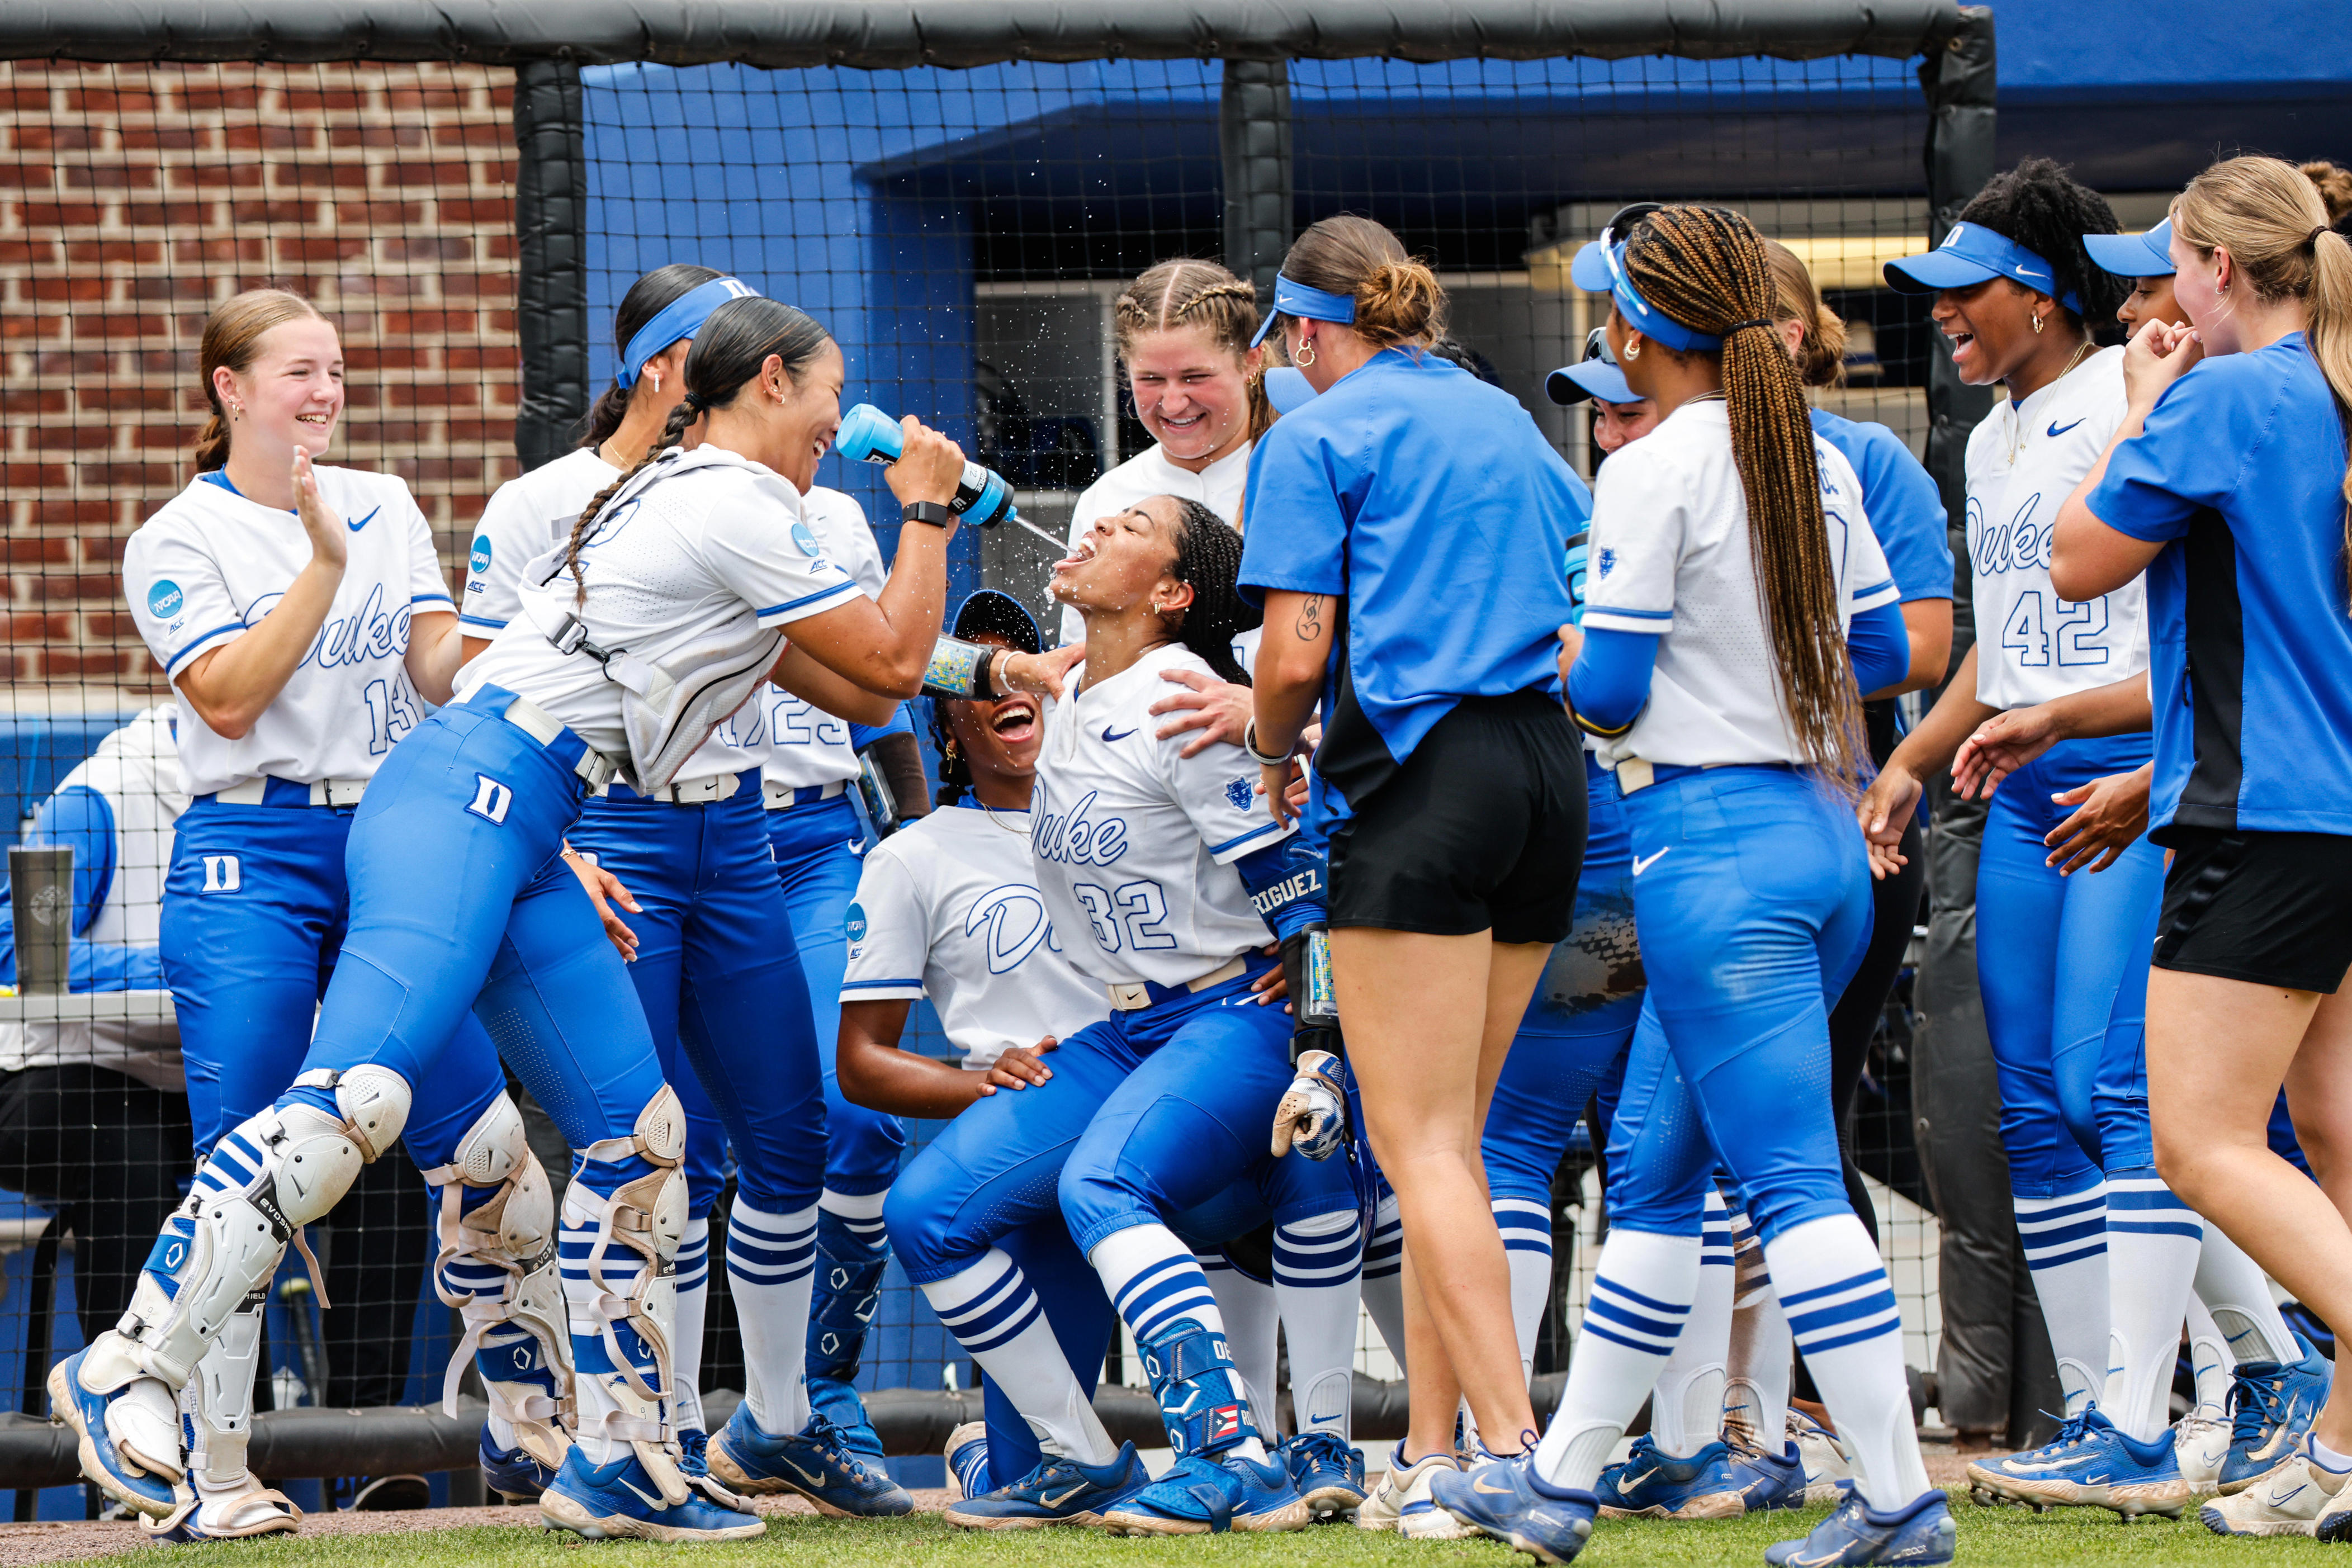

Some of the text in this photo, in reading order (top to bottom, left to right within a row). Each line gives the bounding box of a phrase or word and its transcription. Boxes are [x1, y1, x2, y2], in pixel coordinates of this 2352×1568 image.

[471, 551, 490, 564] NCAA
[810, 560, 827, 572] ACC
[467, 580, 486, 593] ACC
[154, 590, 182, 613] NCAA
[169, 617, 184, 634] ACC
[2003, 591, 2109, 666] 42
[468, 775, 513, 823] D
[202, 855, 240, 892] D
[1073, 879, 1178, 954] 32
[847, 920, 865, 932] NCAA
[850, 946, 863, 958] ACC
